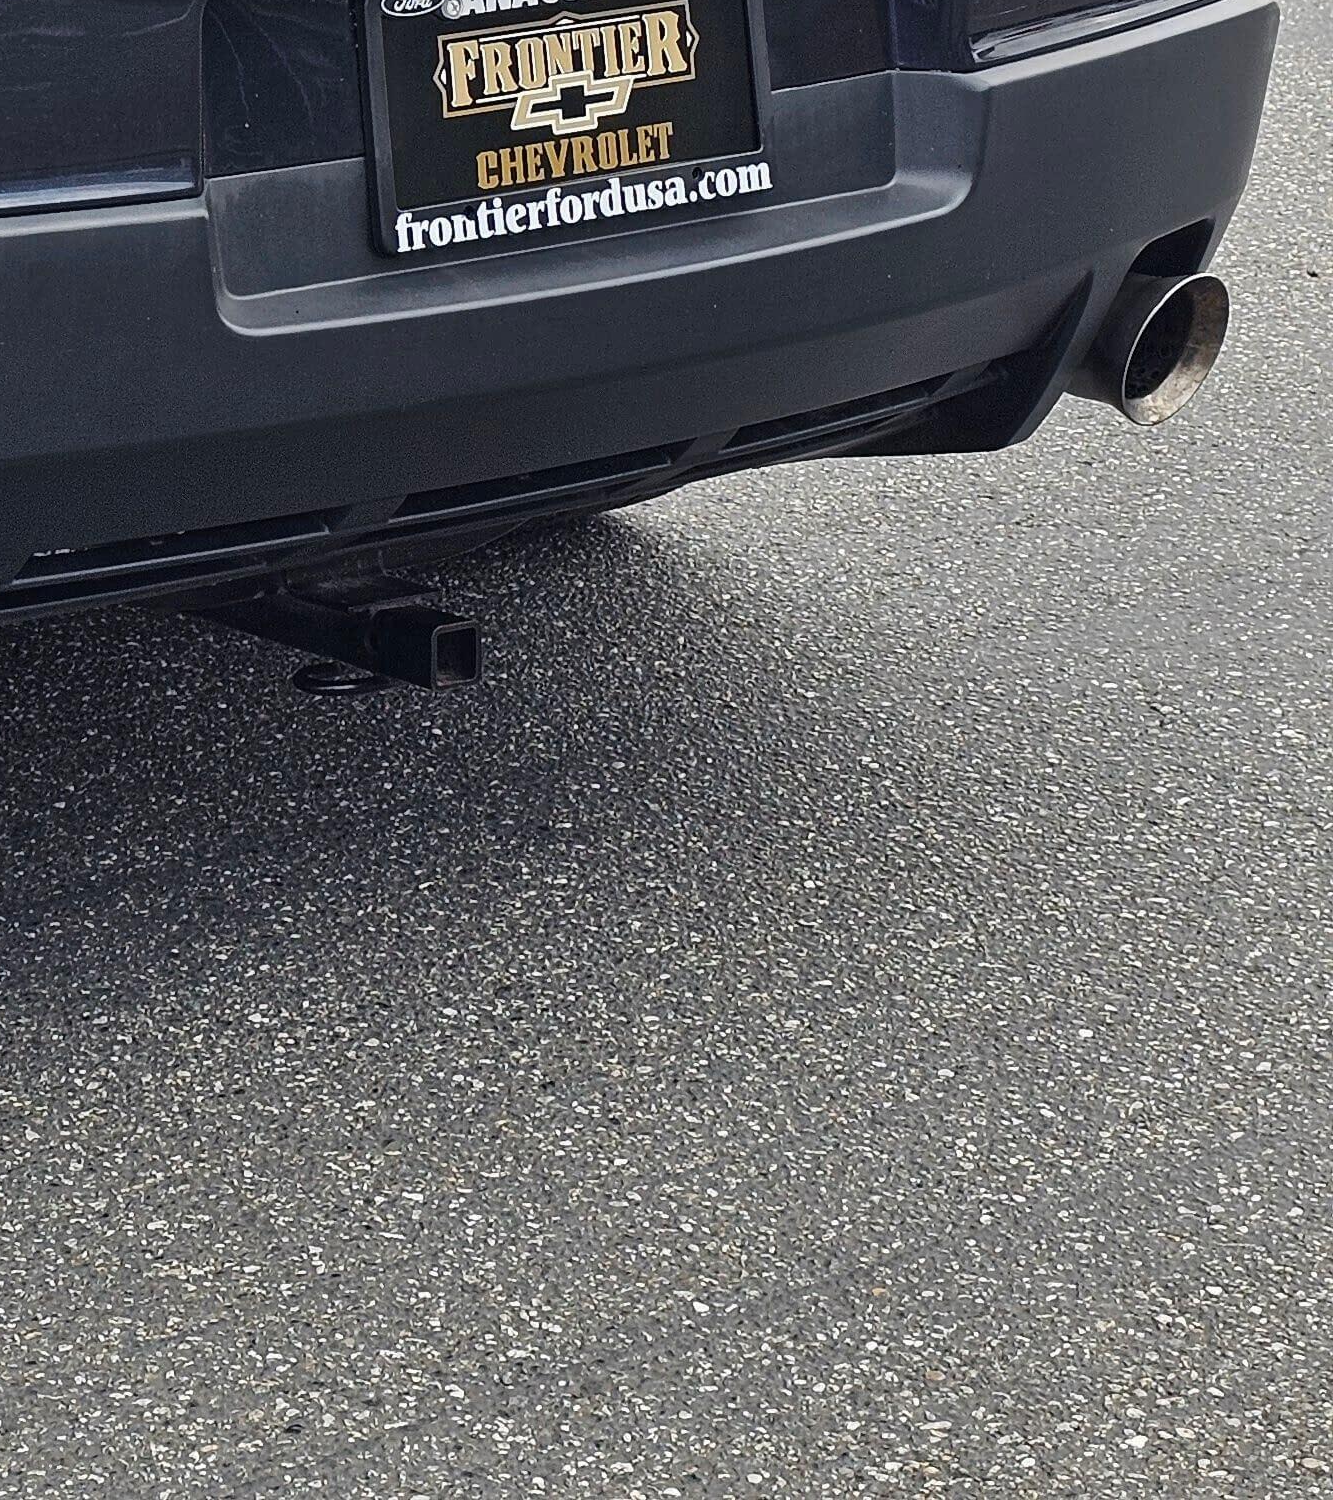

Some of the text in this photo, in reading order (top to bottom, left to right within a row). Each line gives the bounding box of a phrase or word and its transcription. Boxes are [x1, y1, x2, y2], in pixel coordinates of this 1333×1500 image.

[446, 11, 689, 109] FRONTIER
[476, 121, 674, 190] CHEVROLET
[394, 161, 773, 254] frontierfordusa.com
